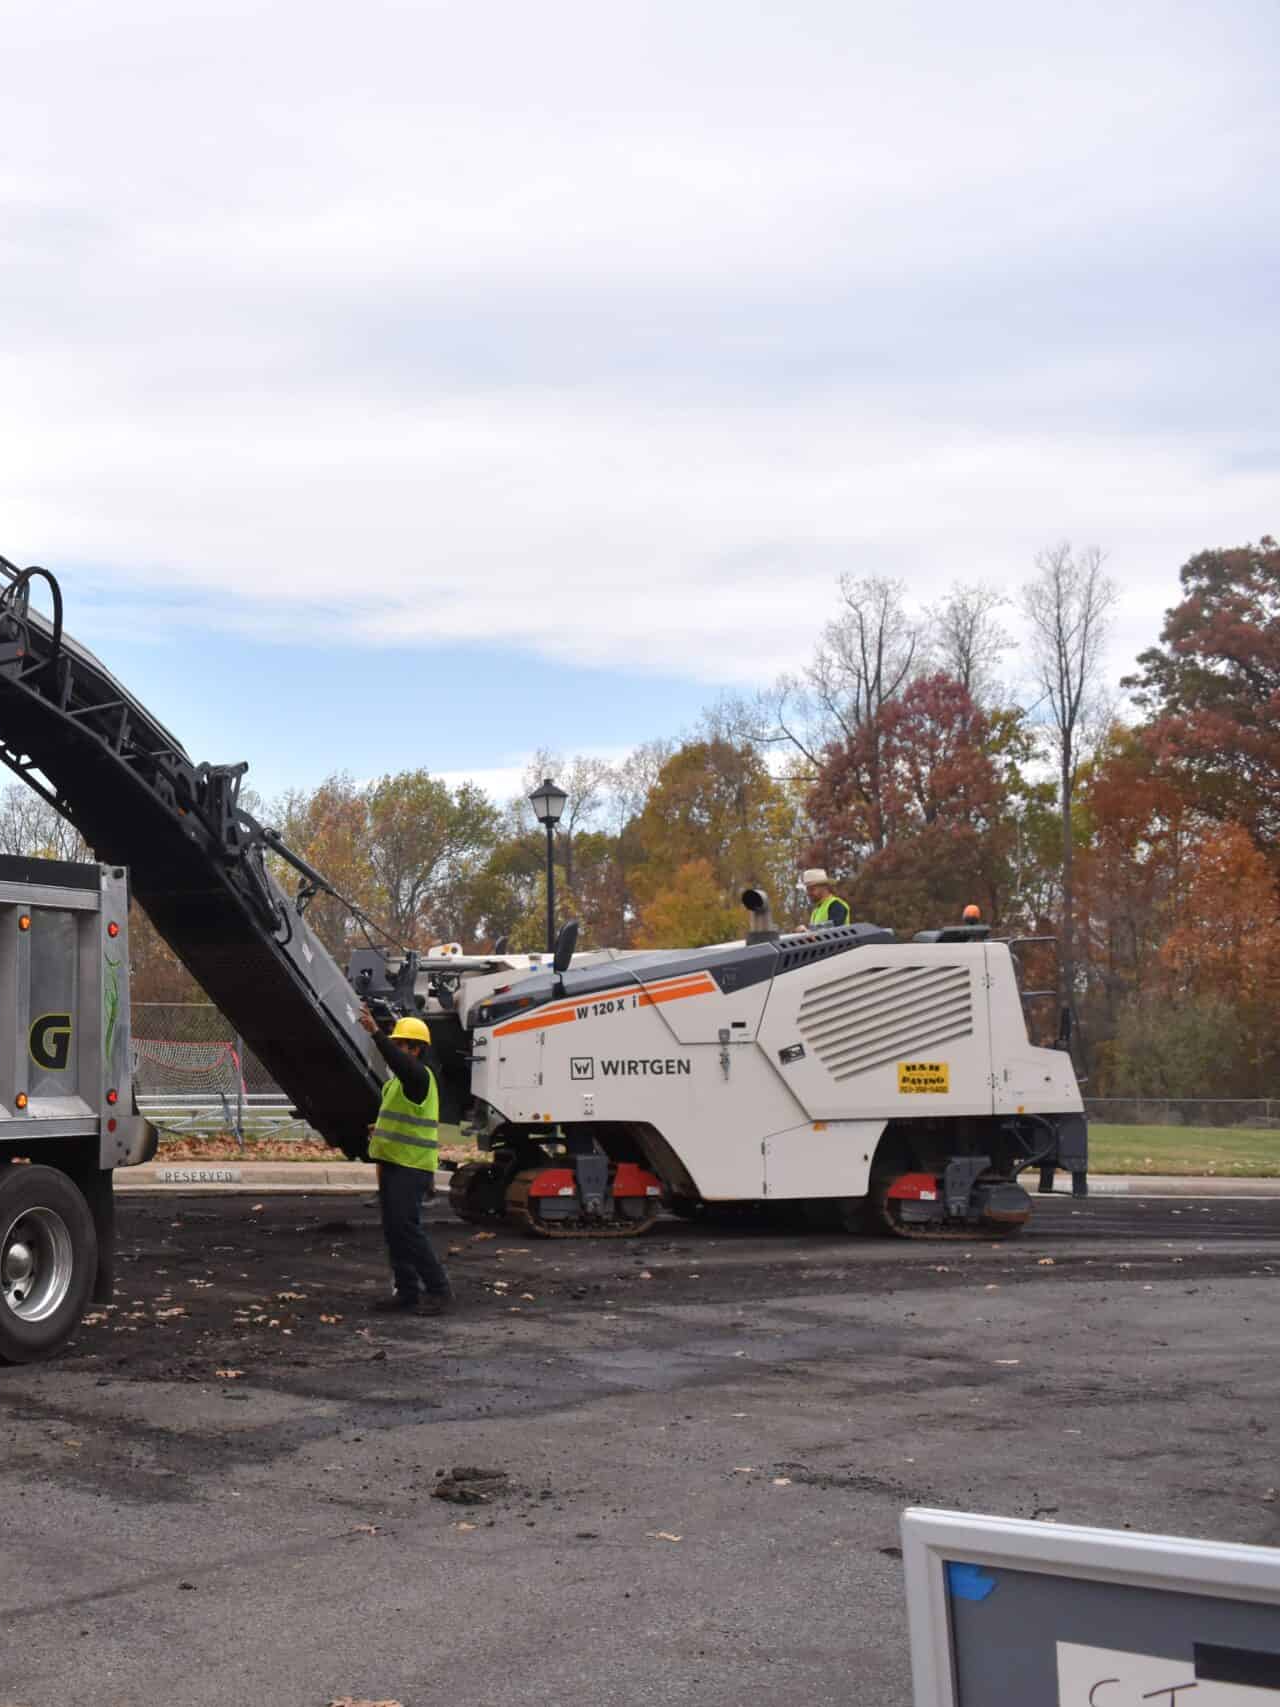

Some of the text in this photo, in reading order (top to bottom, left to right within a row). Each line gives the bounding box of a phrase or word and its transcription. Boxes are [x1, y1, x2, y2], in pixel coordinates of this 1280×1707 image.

[576, 1007, 588, 1020] W
[592, 1000, 614, 1017] 120
[601, 1059, 691, 1076] WIRTGEN
[164, 1170, 233, 1184] RESERVED
